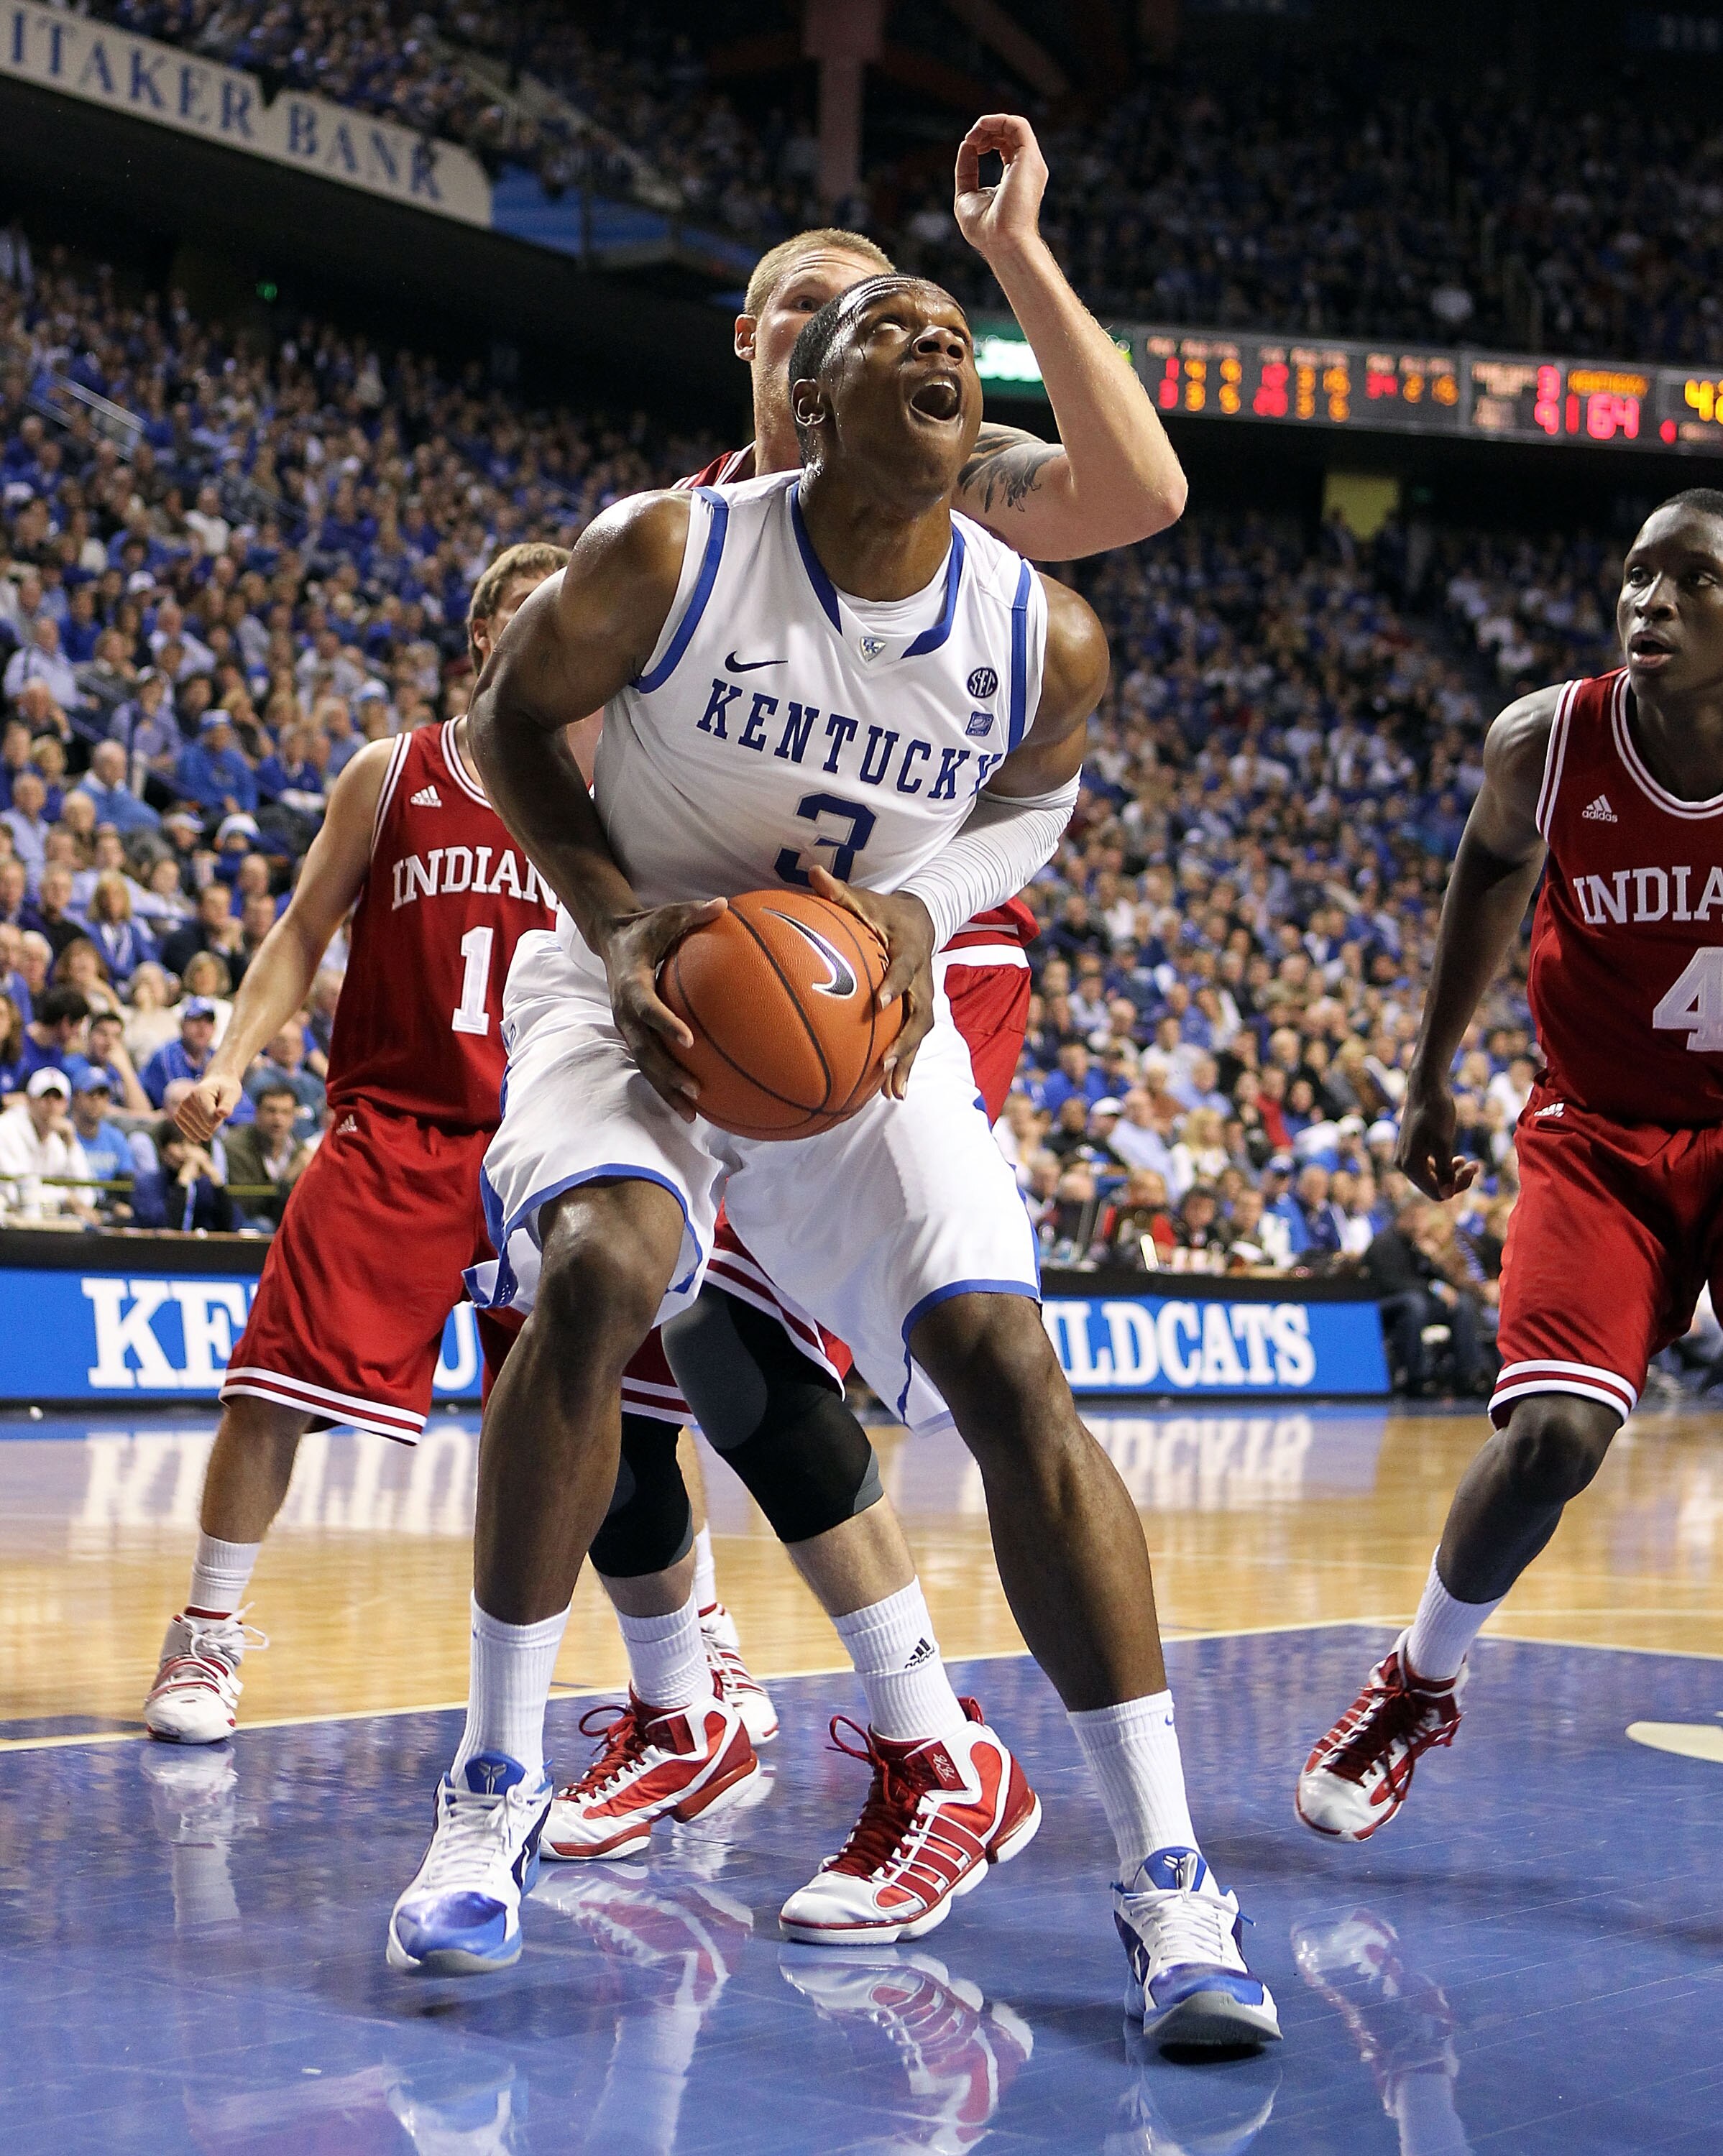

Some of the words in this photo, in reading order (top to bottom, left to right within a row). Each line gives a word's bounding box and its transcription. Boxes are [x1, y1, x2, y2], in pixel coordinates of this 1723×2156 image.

[289, 103, 443, 202] BANK
[970, 669, 995, 696] SEC
[697, 678, 1003, 800] KENTUCKY
[773, 793, 877, 886] 3
[1582, 809, 1618, 823] adidas
[451, 926, 494, 1036] 1
[1653, 946, 1723, 1052] 4
